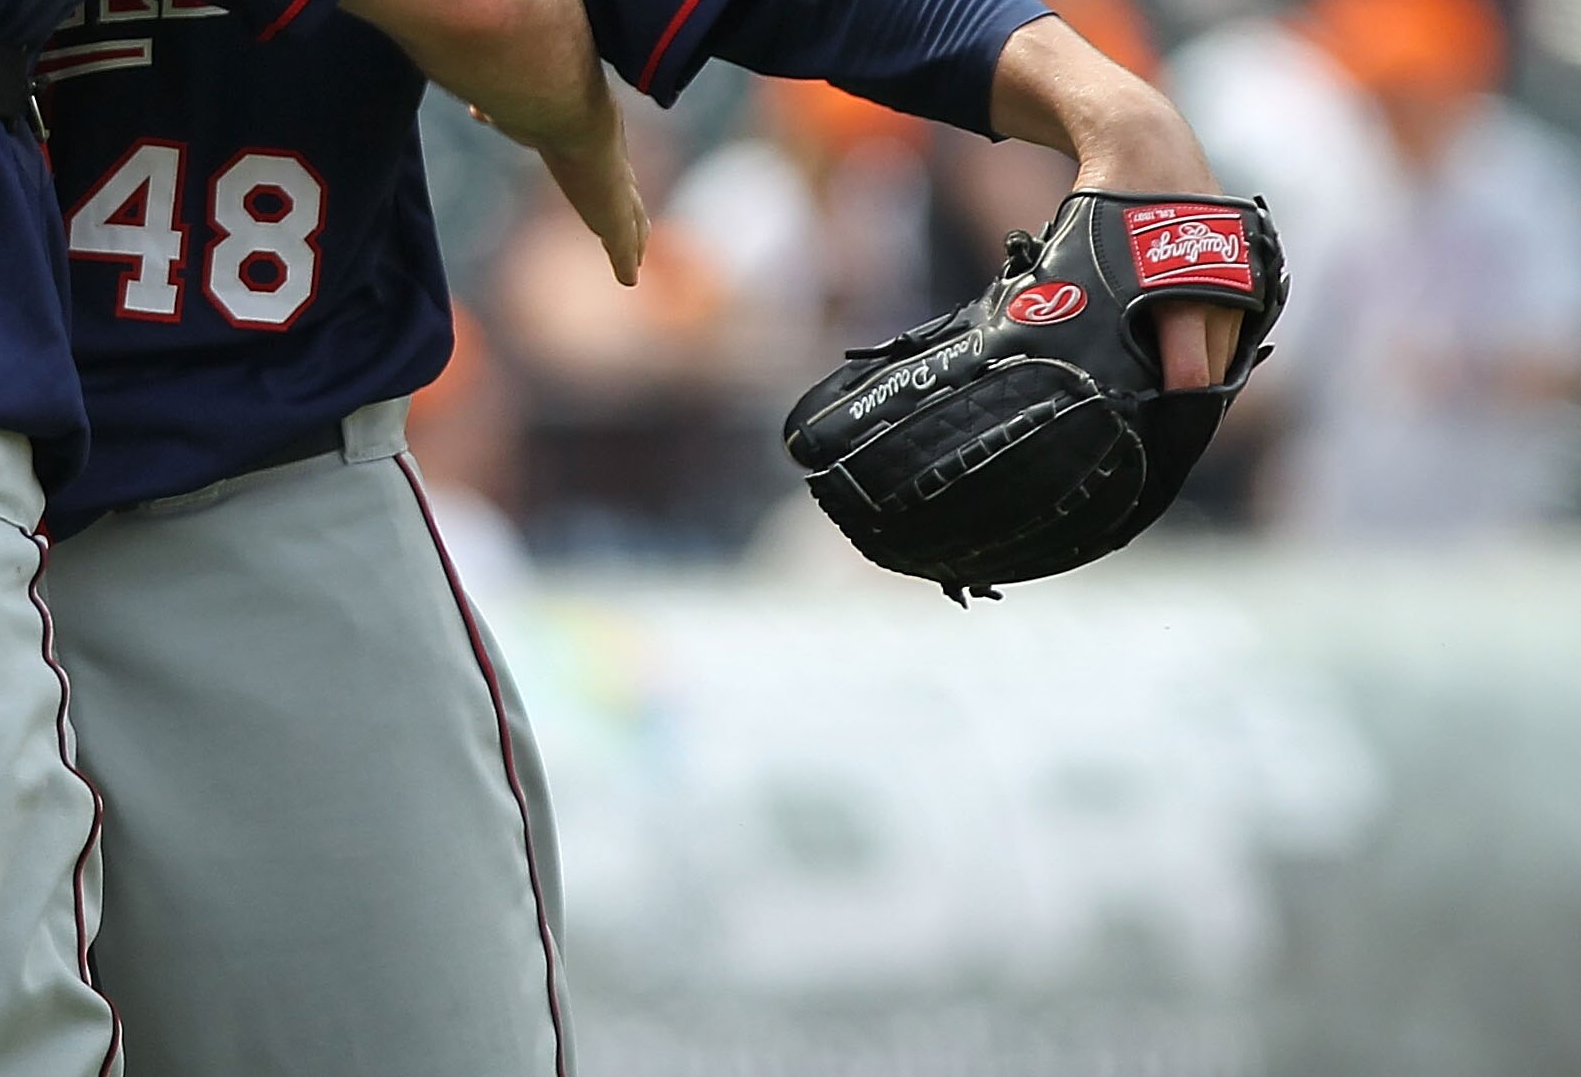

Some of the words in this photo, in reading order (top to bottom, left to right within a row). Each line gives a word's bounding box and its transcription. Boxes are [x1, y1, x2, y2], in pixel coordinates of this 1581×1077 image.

[69, 137, 329, 331] 48
[1146, 229, 1239, 263] Rawlings
[936, 328, 985, 371] Carl
[848, 357, 937, 420] Pavano
